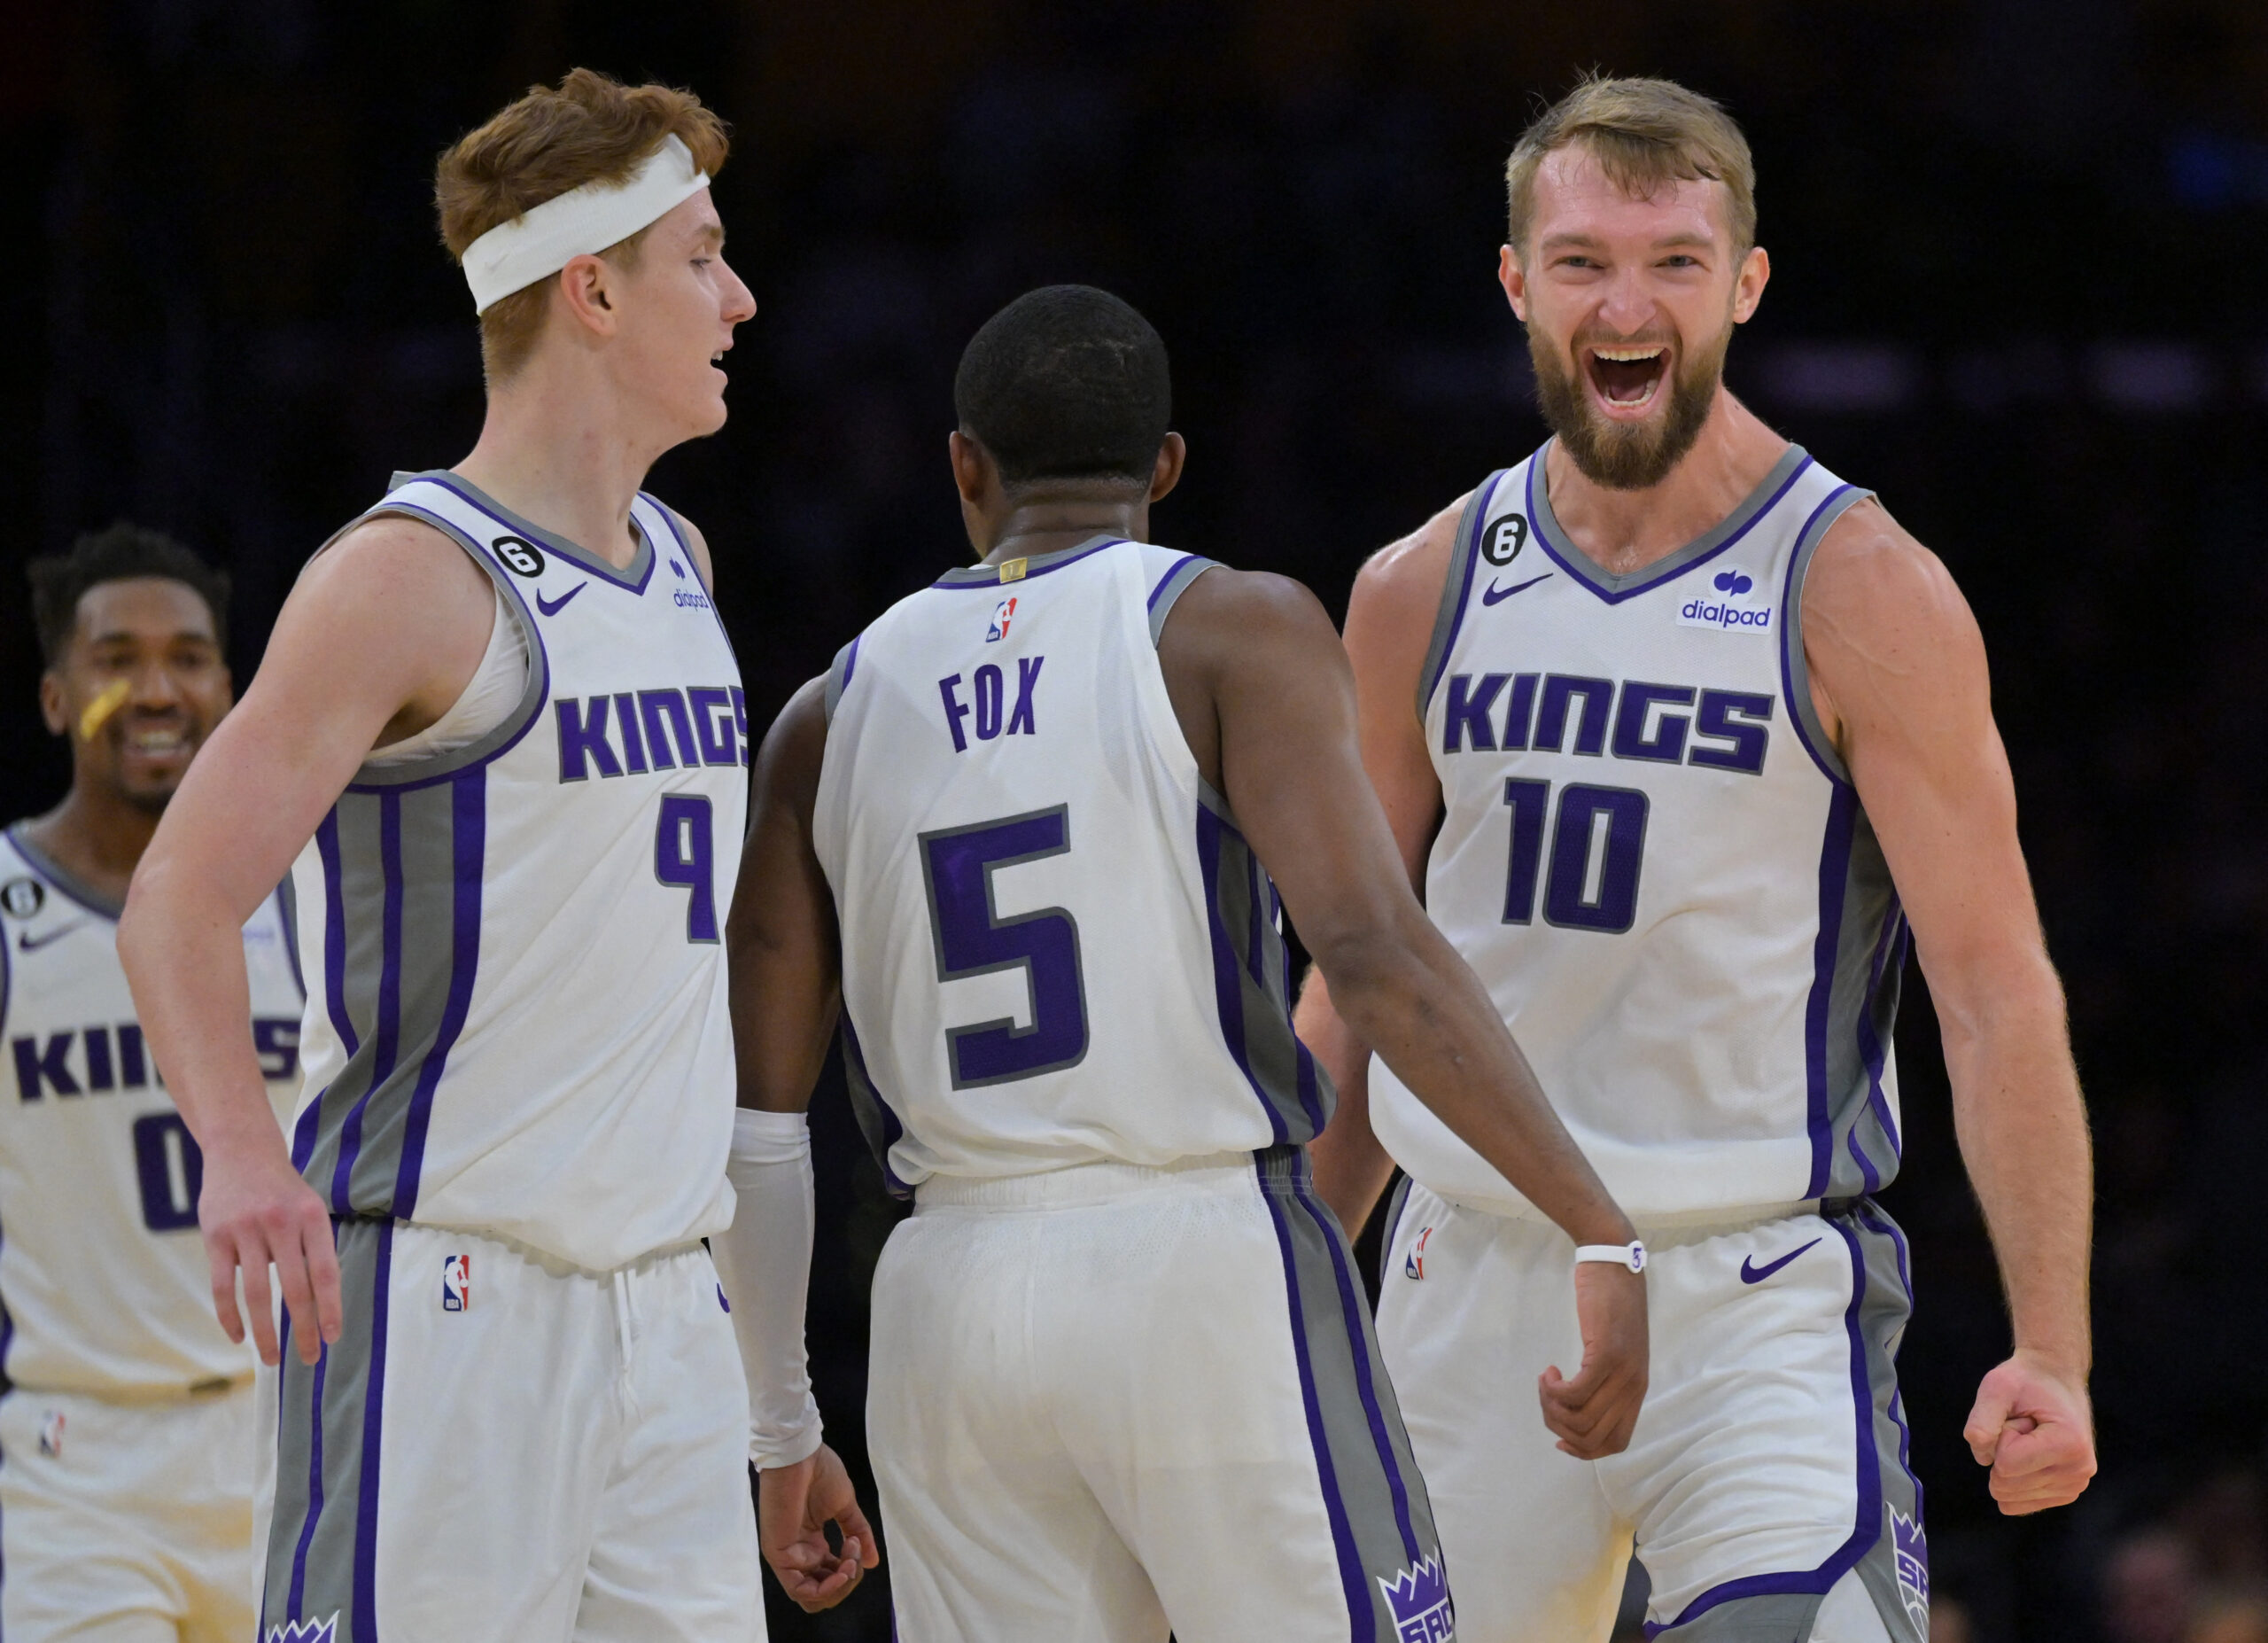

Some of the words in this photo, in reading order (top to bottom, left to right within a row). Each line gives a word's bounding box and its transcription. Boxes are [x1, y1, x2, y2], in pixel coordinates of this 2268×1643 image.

[499, 541, 538, 573] 6
[1494, 520, 1518, 558] 6
[1682, 599, 1771, 628] dialpad
[939, 656, 1045, 753] FOX
[1442, 672, 1775, 777] KINGS
[654, 792, 721, 945] 9
[1502, 776, 1651, 936] 10
[918, 803, 1091, 1091] 5
[12, 1019, 301, 1102] KIS
